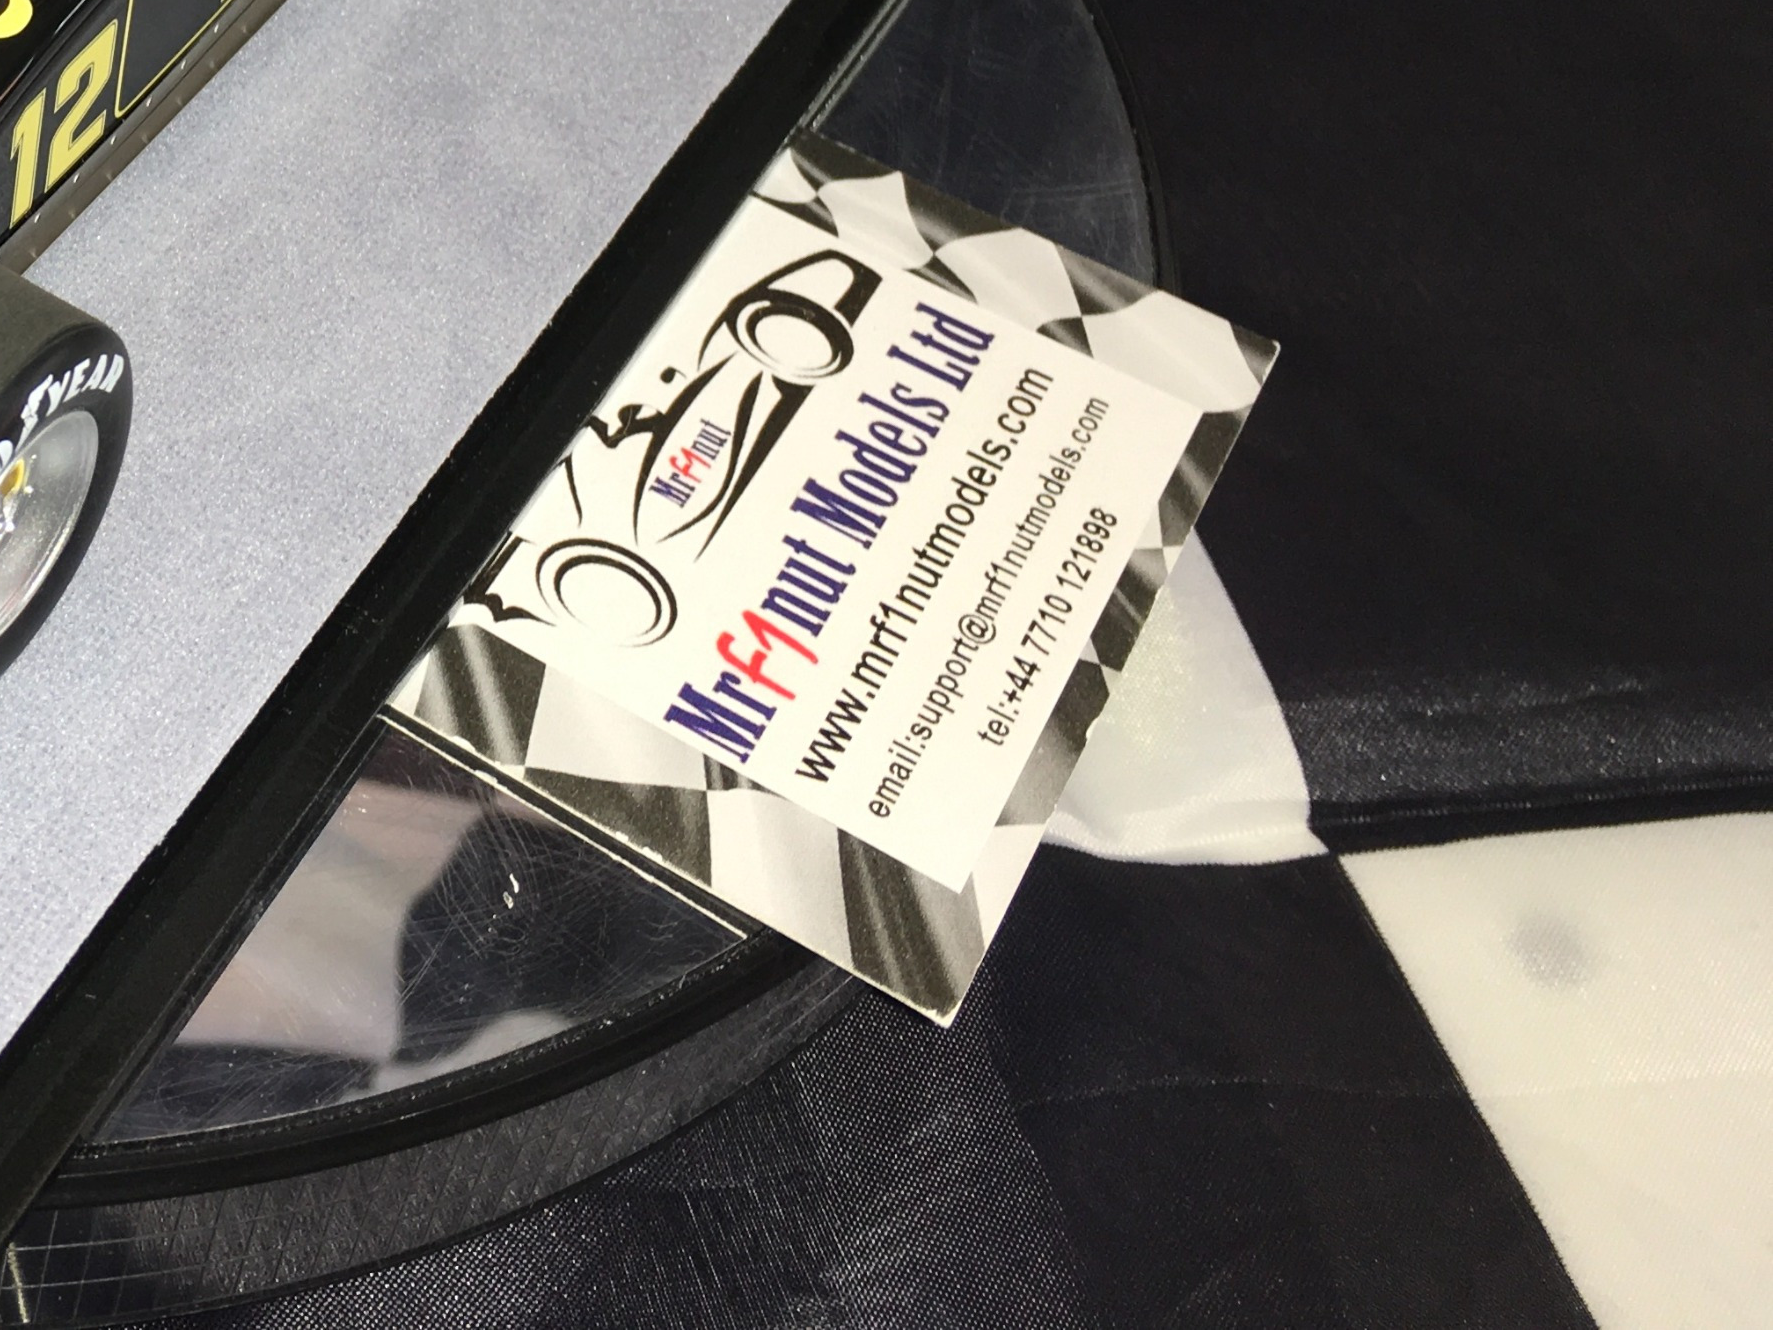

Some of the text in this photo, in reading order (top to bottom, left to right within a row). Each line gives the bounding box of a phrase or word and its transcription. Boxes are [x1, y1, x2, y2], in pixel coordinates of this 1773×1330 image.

[9, 19, 119, 229] 12
[790, 381, 950, 550] Models
[887, 301, 995, 392] Ltd
[795, 367, 1054, 783] www.mrf1nutmodels.com
[868, 397, 1109, 819] email:support@mrf1nutmodels.com
[977, 506, 1119, 748] tel:+44 7710 121898
